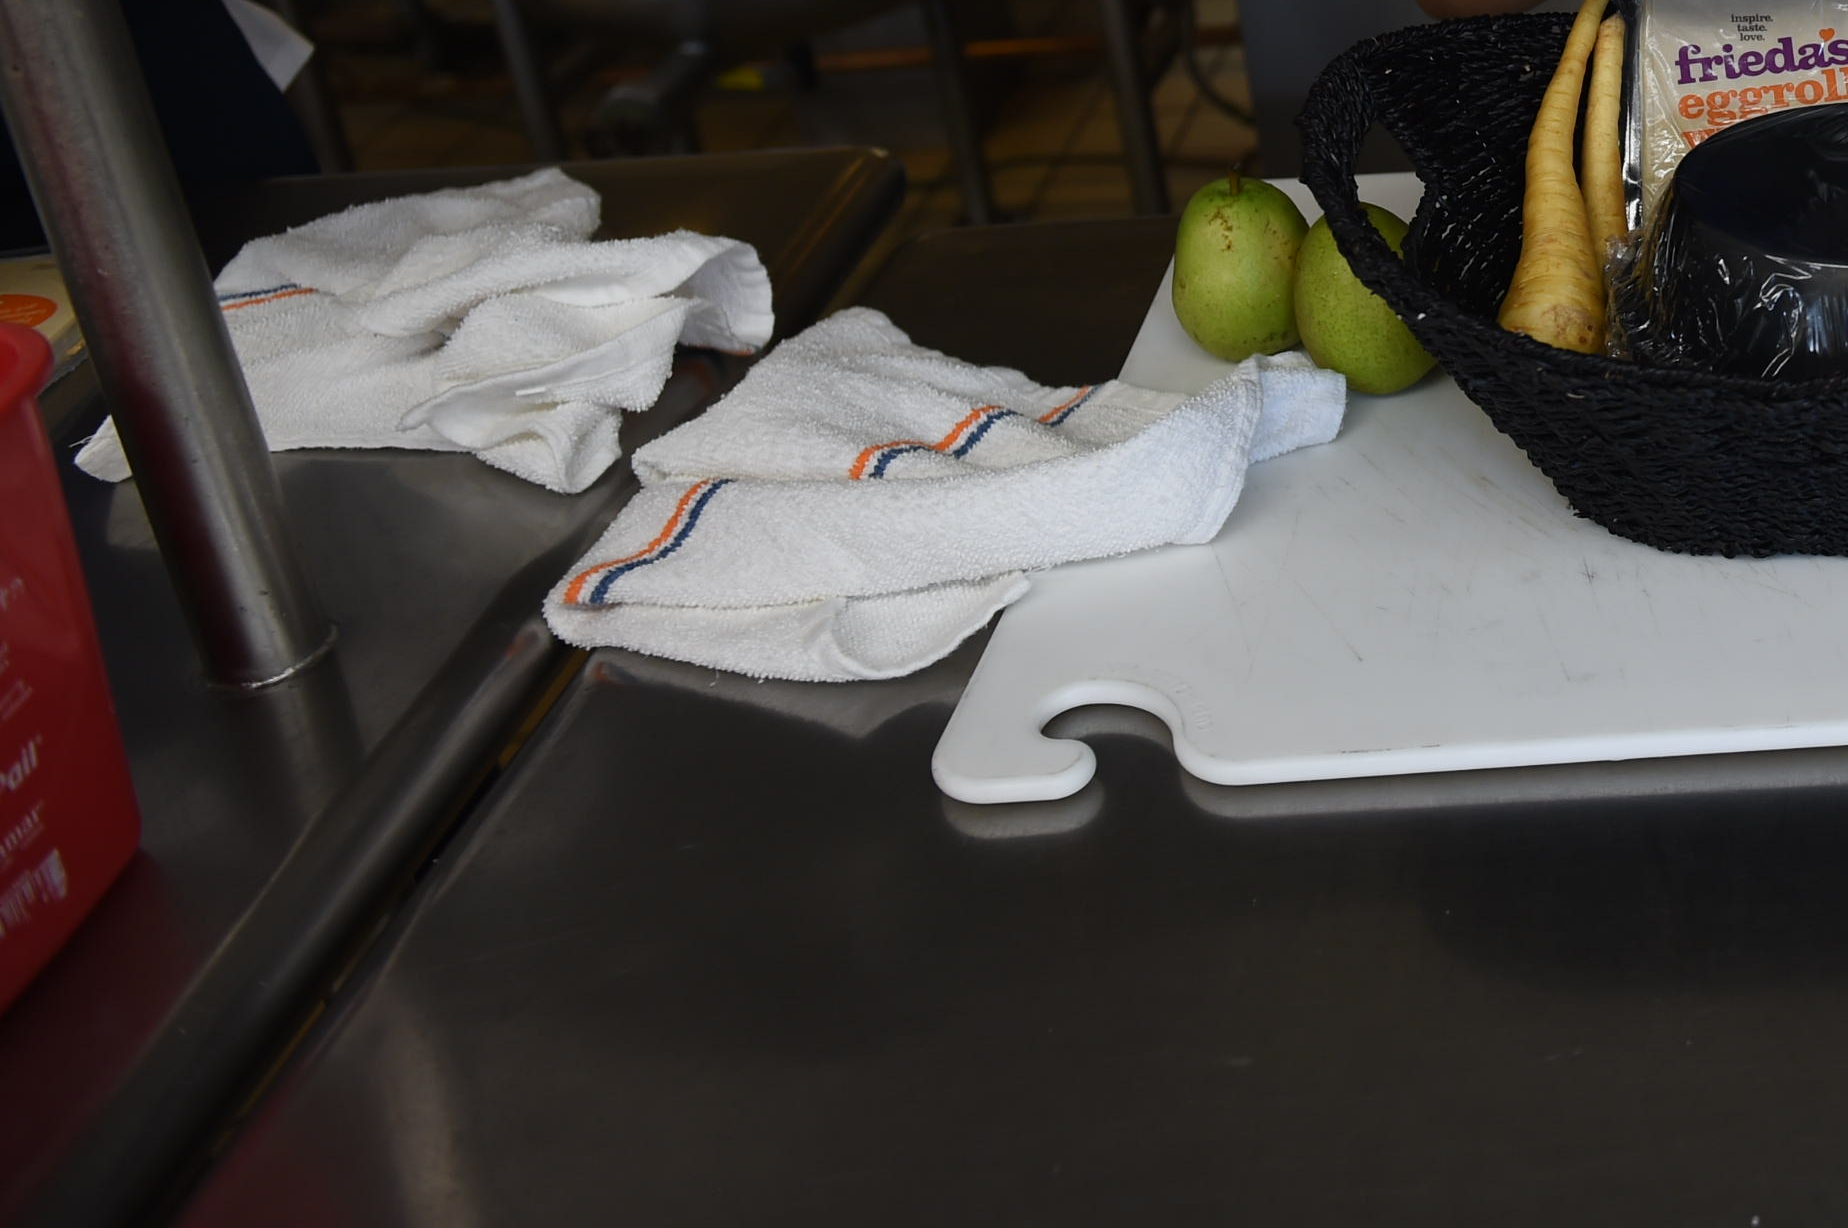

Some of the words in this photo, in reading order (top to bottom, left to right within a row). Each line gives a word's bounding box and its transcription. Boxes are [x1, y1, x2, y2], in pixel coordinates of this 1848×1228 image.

[1730, 13, 1774, 24] inspire.
[1737, 23, 1768, 32] taste.
[1739, 33, 1765, 42] love.
